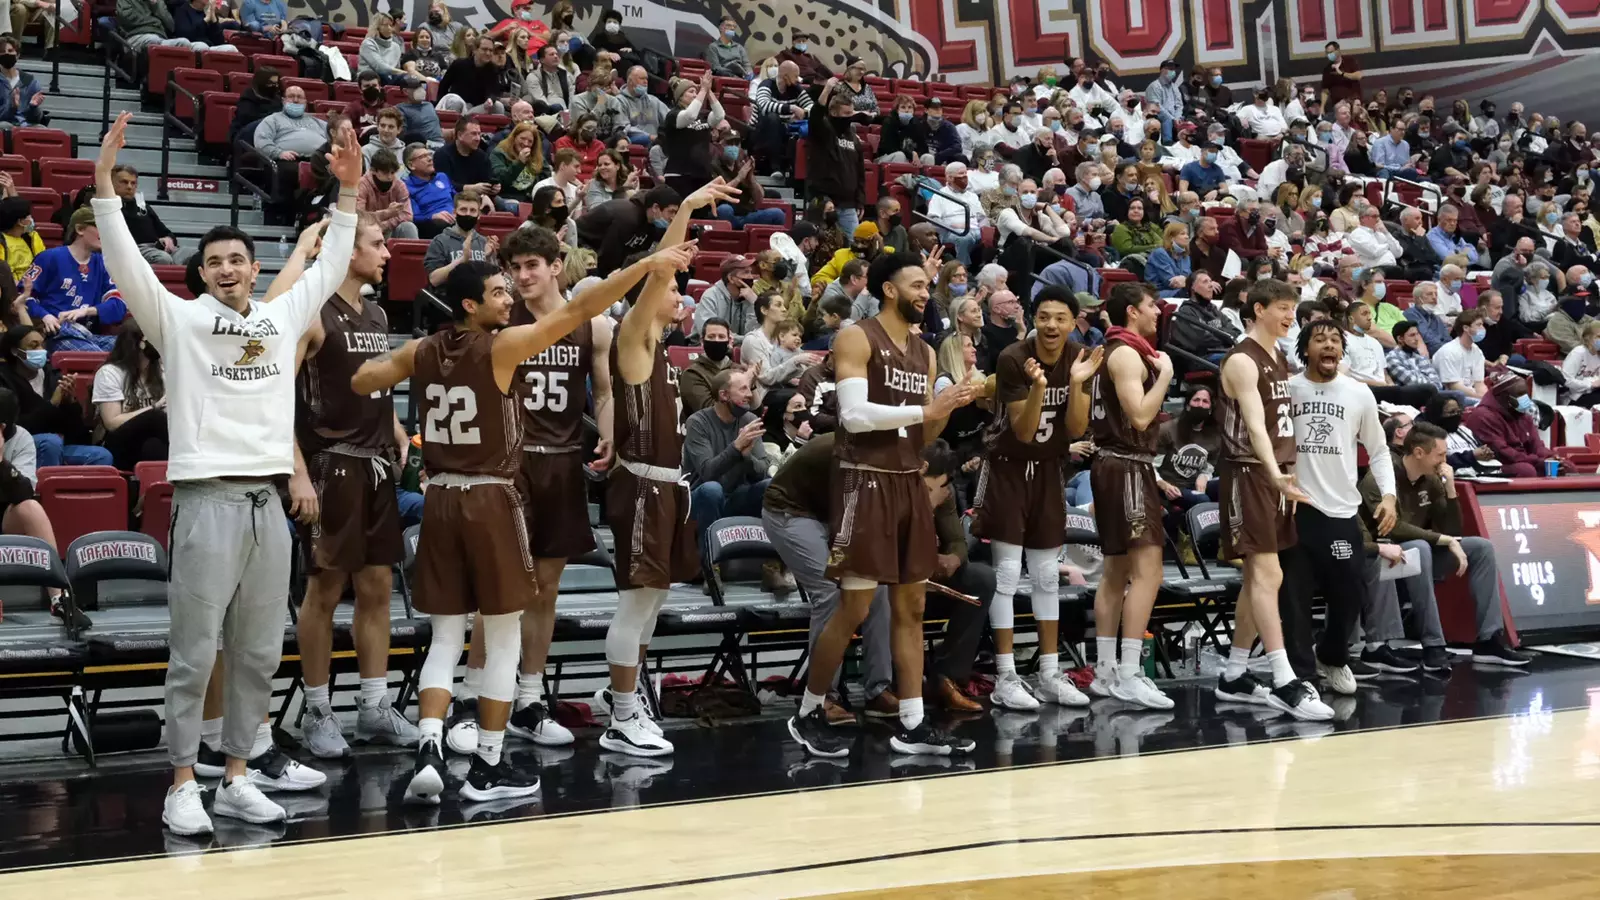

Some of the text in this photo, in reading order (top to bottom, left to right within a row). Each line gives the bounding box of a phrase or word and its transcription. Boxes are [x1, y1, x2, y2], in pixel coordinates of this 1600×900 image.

[622, 4, 643, 18] TM
[166, 181, 203, 190] ection 2
[344, 332, 390, 353] LEHIGH
[211, 363, 281, 381] BASKETBALL
[523, 371, 569, 412] 35
[425, 383, 481, 444] 22
[1293, 402, 1345, 420] LEHIGH
[1035, 411, 1057, 443] 5
[1296, 445, 1343, 455] ASKETBAL
[1498, 507, 1539, 530] T.O.L.
[78, 541, 156, 566] LAFAYETTE
[1515, 533, 1531, 554] 2
[0, 547, 49, 568] YETTE
[1512, 561, 1555, 586] FOULS
[1530, 584, 1545, 606] 9
